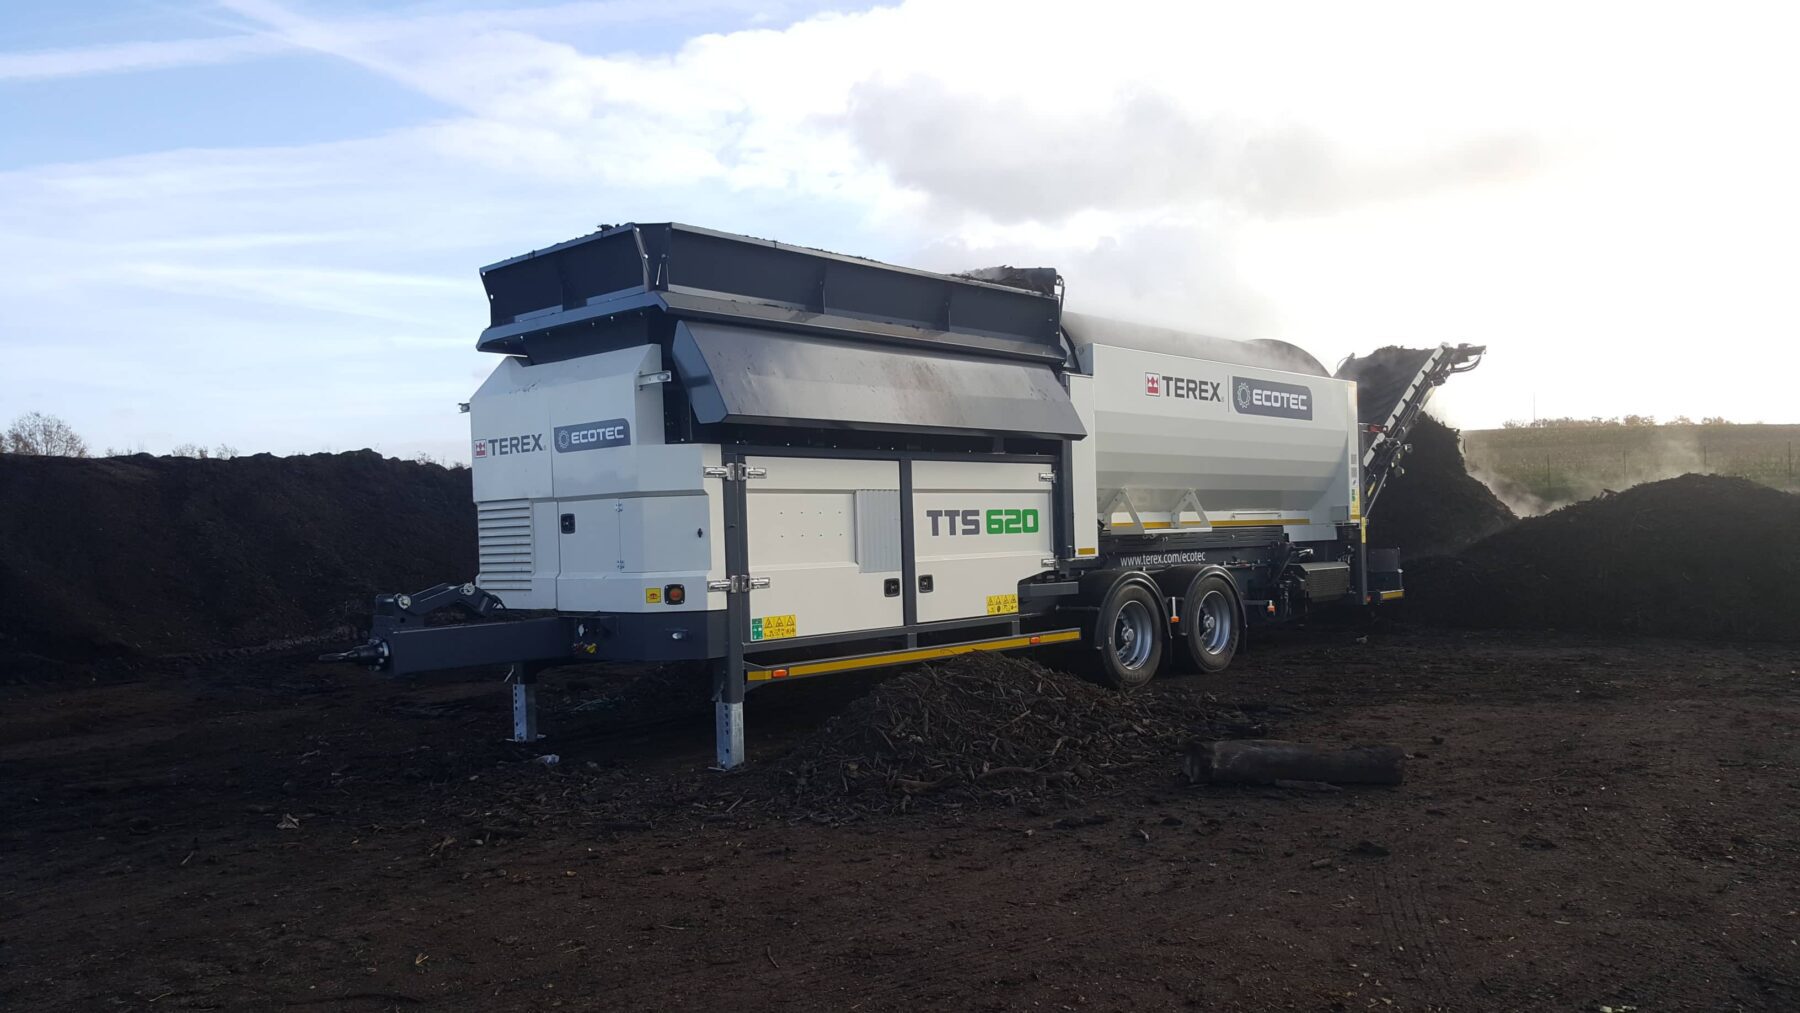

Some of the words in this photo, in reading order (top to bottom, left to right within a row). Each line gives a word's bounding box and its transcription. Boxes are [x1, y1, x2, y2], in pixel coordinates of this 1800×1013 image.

[1162, 376, 1221, 402] TEREX
[1252, 389, 1308, 411] ECOTEC
[488, 433, 544, 457] TEREX
[571, 425, 625, 444] ECOTEC
[926, 509, 980, 536] TTS
[986, 508, 1039, 534] 620
[1120, 551, 1206, 567] www.terex.com/ecotec
